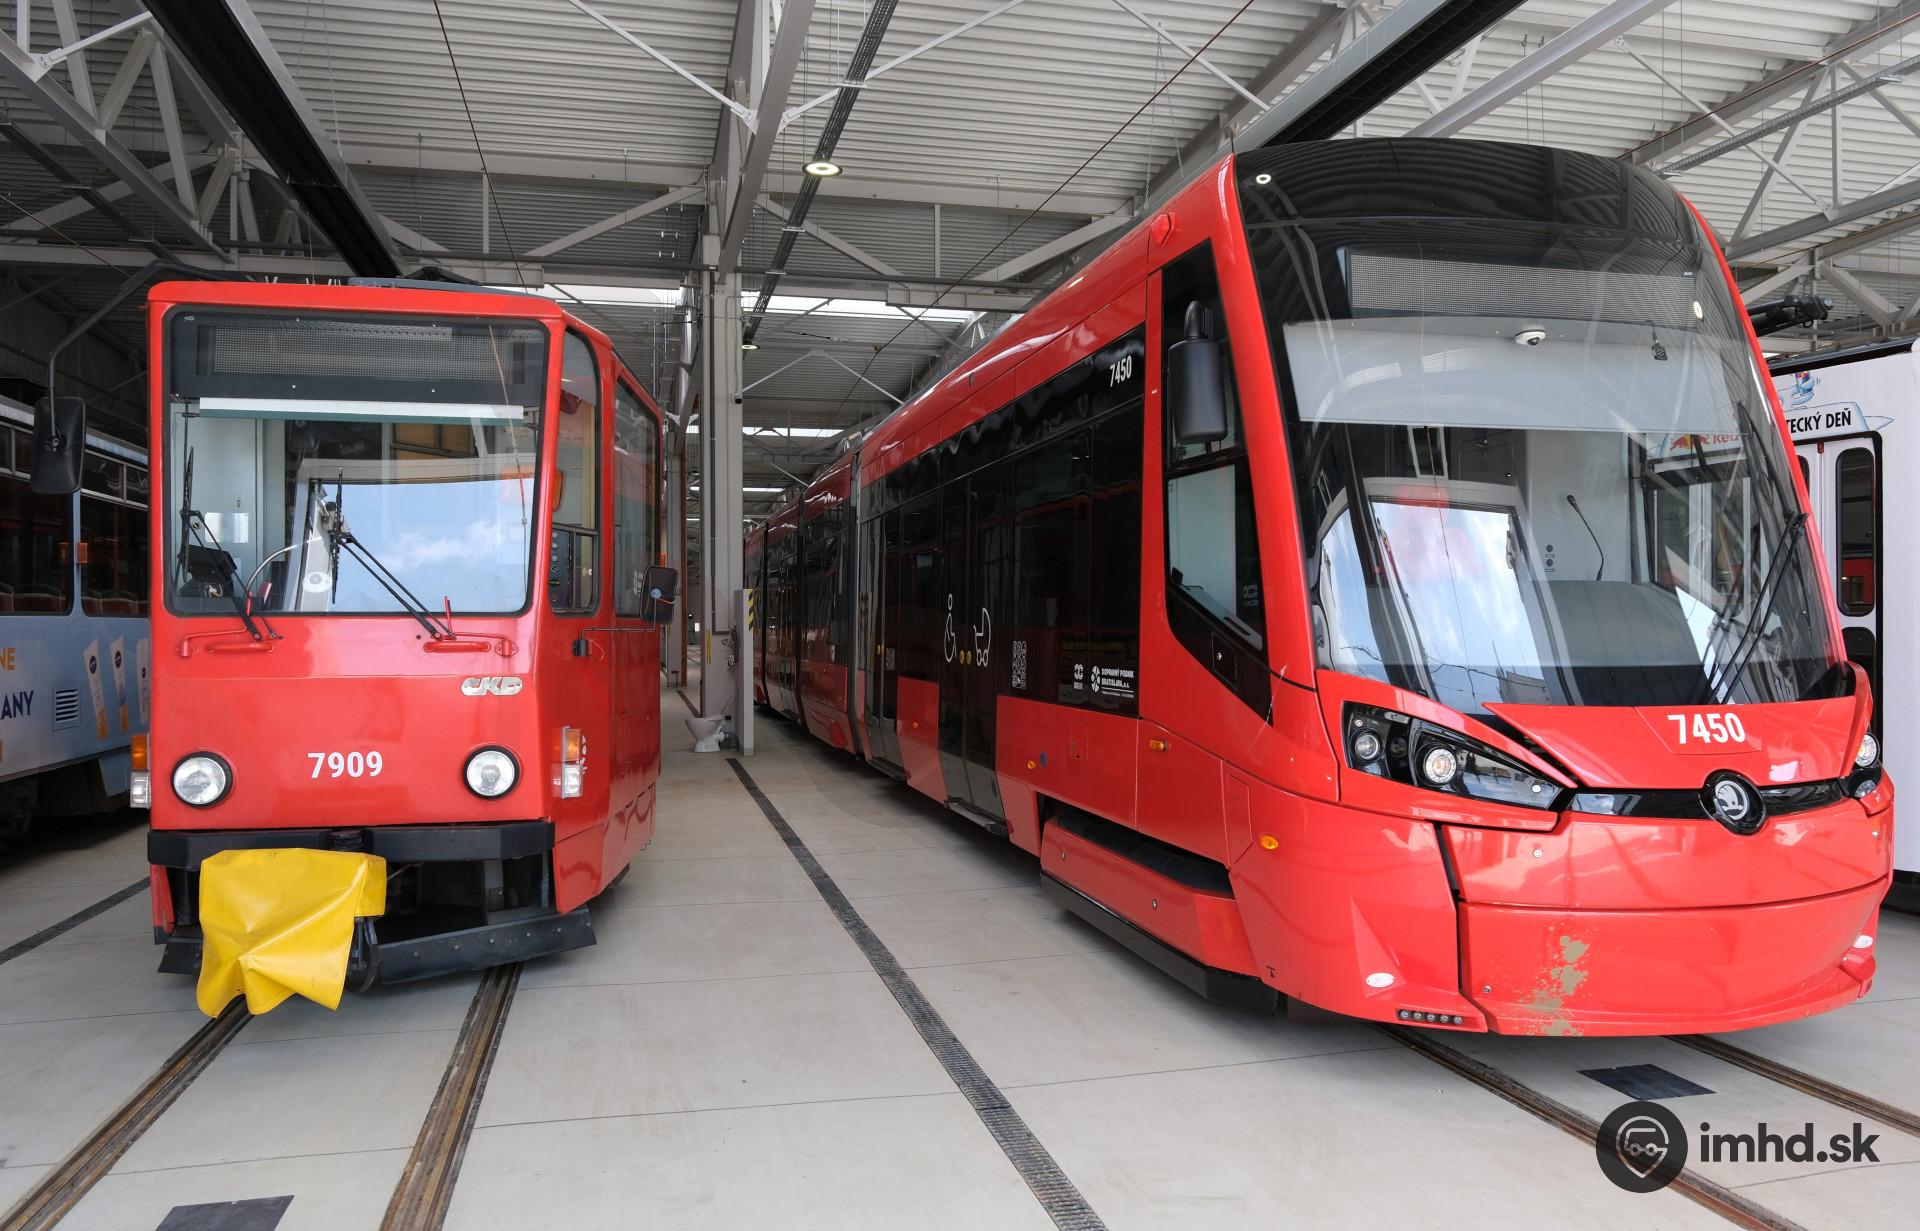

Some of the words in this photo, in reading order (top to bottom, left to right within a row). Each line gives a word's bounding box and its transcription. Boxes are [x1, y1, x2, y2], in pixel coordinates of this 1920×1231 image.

[1110, 355, 1132, 387] 7450
[1825, 407, 1852, 429] DEŇ
[1667, 712, 1746, 745] 7450
[307, 751, 383, 779] 7909
